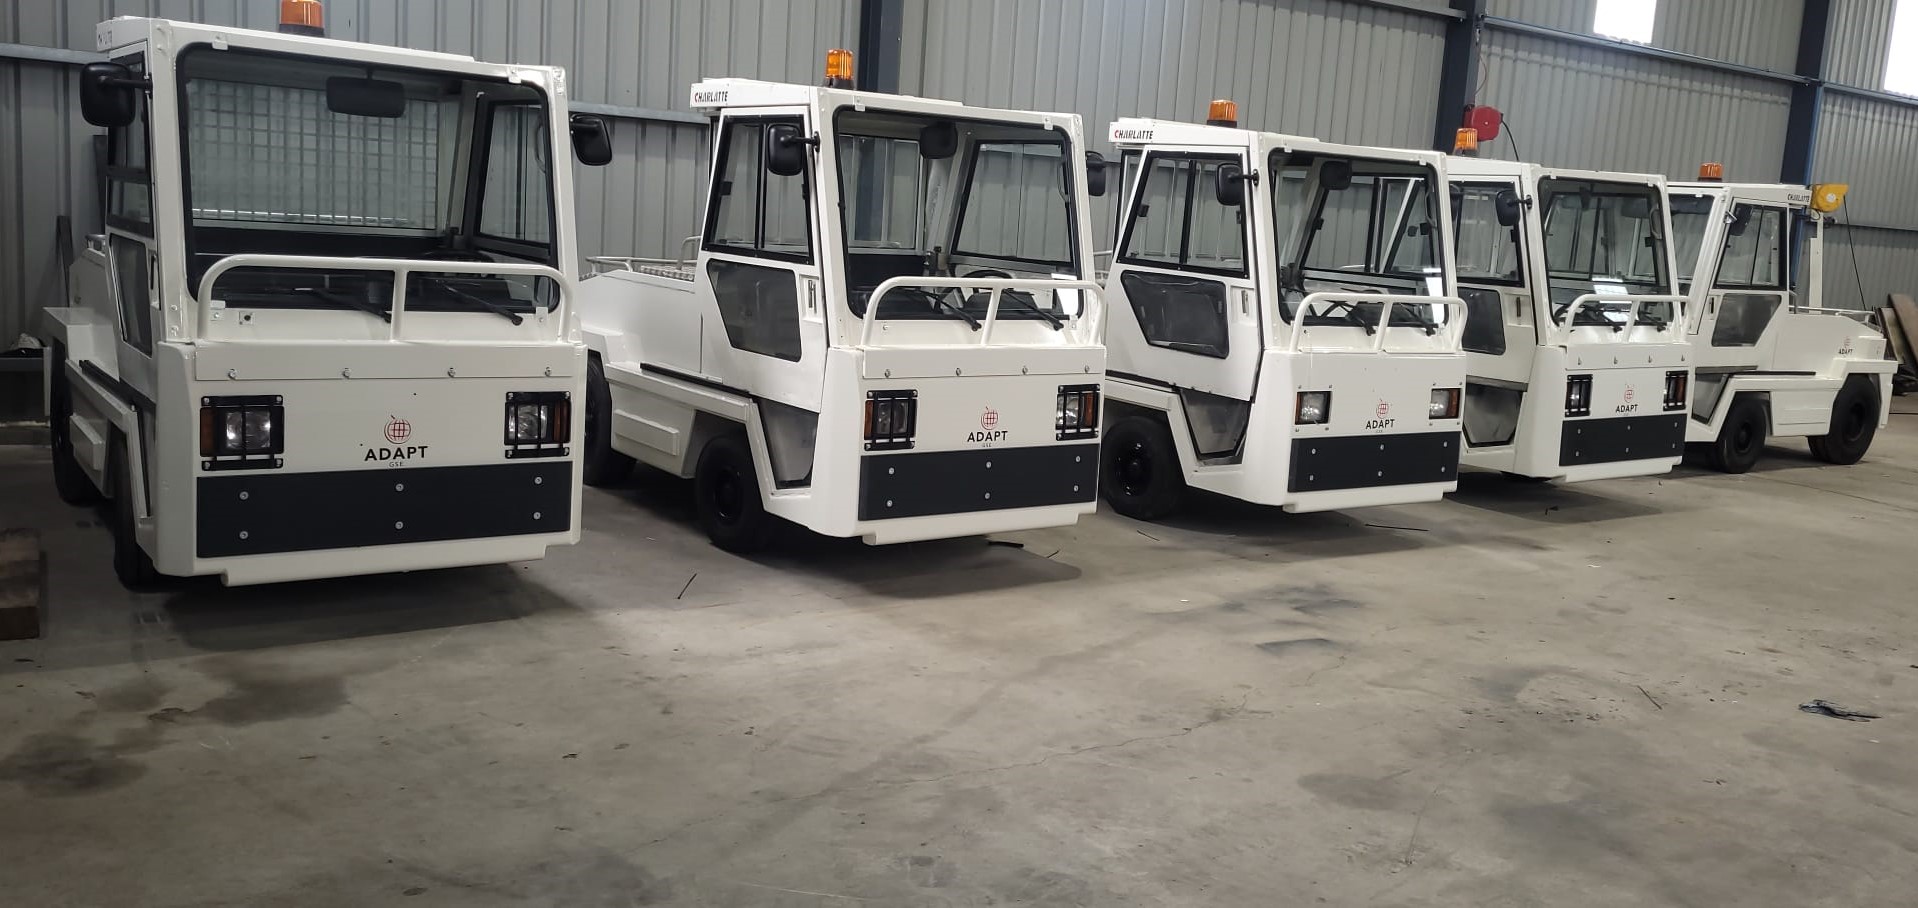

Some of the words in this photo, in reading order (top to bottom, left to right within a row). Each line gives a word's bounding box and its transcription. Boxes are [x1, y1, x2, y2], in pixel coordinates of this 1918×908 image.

[694, 91, 728, 103] CHARLATTE
[1114, 129, 1153, 139] CHARLATTE
[1615, 404, 1638, 413] ADAPT
[1365, 418, 1395, 430] ADAPT
[967, 430, 1008, 442] ADAPT
[364, 445, 428, 461] ADAPT
